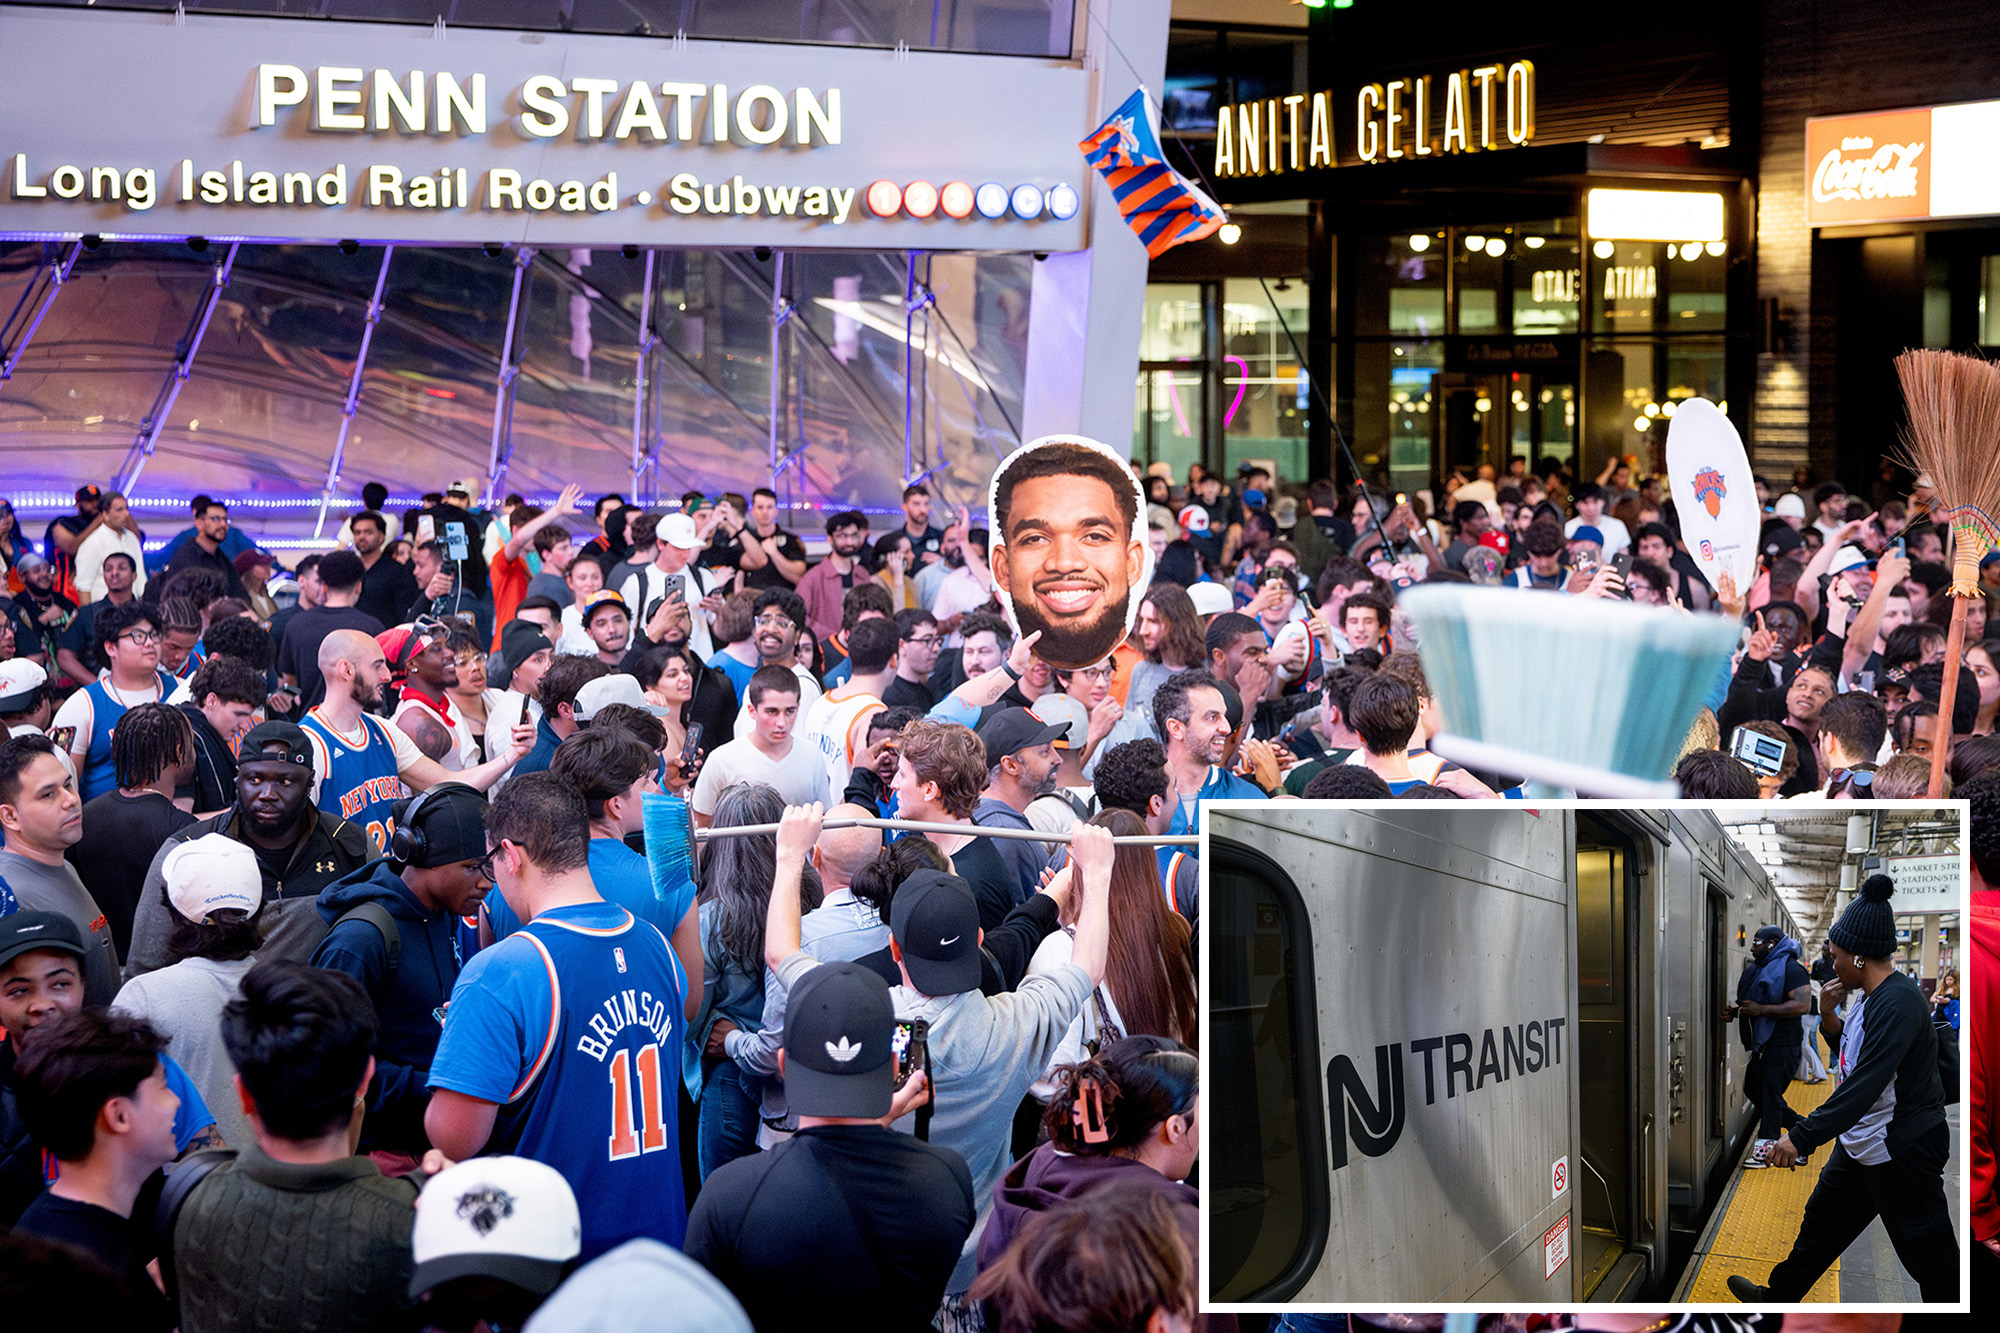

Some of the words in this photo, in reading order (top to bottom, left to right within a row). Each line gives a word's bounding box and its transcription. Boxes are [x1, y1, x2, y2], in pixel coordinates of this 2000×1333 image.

[258, 63, 487, 134] PENN
[520, 74, 842, 145] STATION
[1215, 92, 1331, 177] ANITA
[1357, 61, 1529, 162] GELATO
[15, 153, 157, 211] Long
[181, 158, 348, 205] Island
[369, 164, 468, 208] Rail
[488, 168, 619, 212] Road
[669, 172, 856, 225] Subway
[339, 784, 368, 820] NEW
[363, 775, 402, 804] YORK
[1902, 864, 1939, 872] MARKET
[1902, 886, 1937, 895] TICKETS
[577, 988, 673, 1063] BRUNSON
[608, 1042, 668, 1162] 11
[1326, 1042, 1406, 1171] NJ
[1411, 1017, 1566, 1106] TRANSIT
[1546, 1219, 1567, 1245] DANGER
